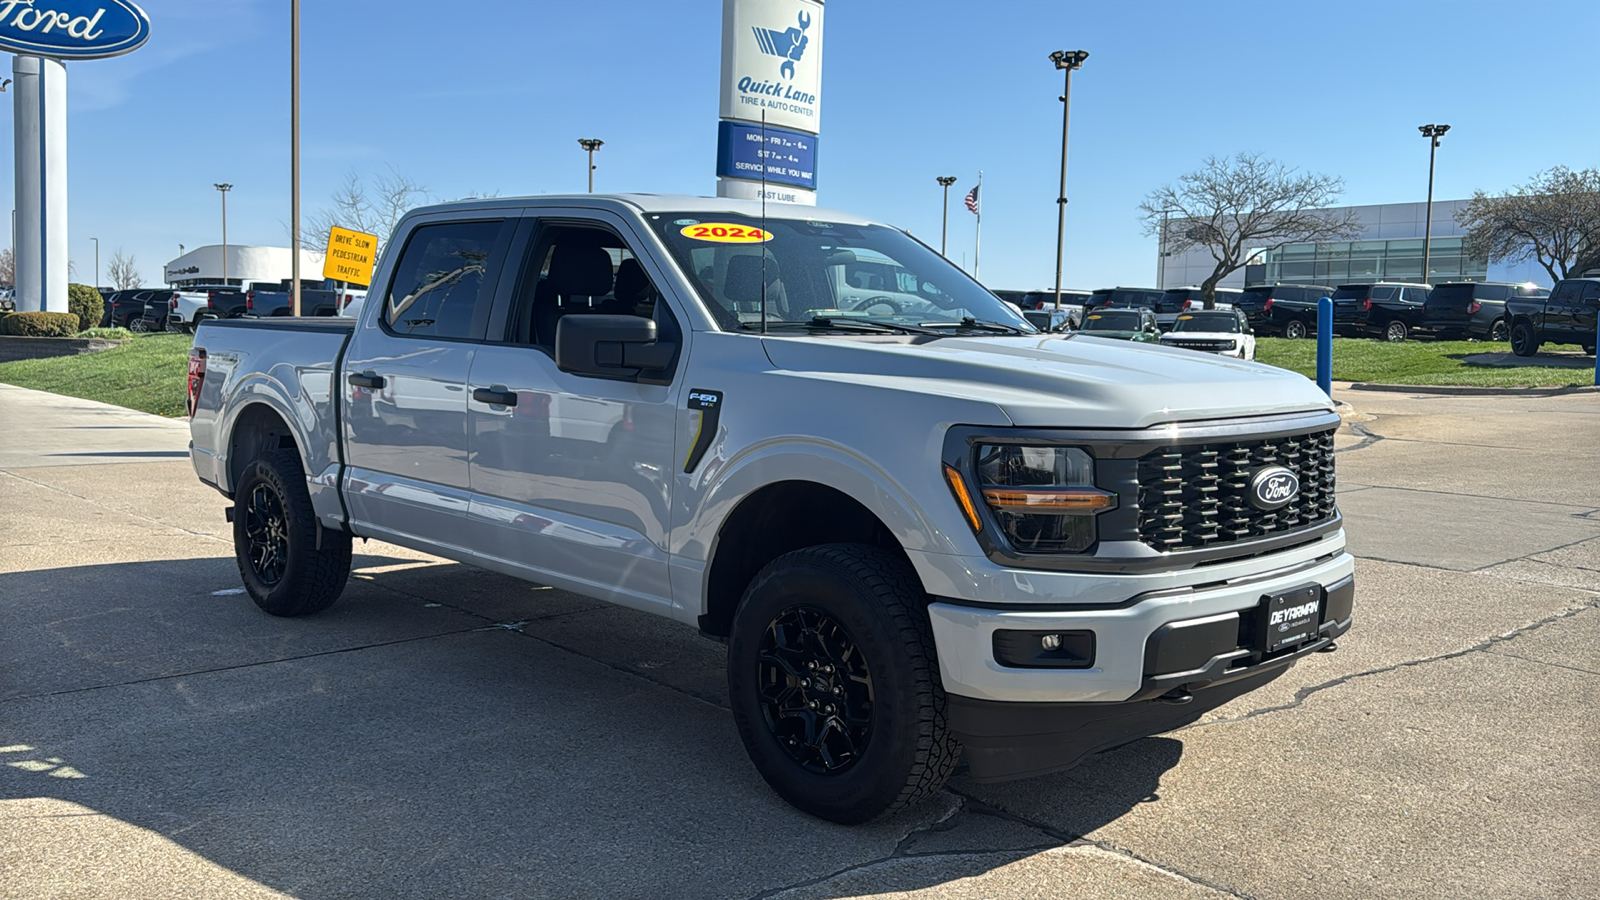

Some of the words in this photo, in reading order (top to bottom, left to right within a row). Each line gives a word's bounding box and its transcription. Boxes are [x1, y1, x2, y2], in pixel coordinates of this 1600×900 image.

[737, 76, 784, 97] Quick
[784, 85, 816, 105] Lane
[740, 95, 759, 106] TIRE
[760, 98, 766, 107] &
[767, 100, 788, 111] AUTO
[789, 104, 814, 117] CENTER
[746, 133, 763, 143] MON
[770, 136, 781, 145] FRI
[767, 165, 787, 175] WHILE
[788, 168, 800, 177] YOU
[801, 171, 813, 179] WAIT
[777, 193, 796, 202] LUBE
[693, 227, 764, 239] 2024
[335, 234, 353, 246] DRIVE
[355, 238, 370, 249] SLOW
[332, 248, 368, 263] PEDESTRIAN
[336, 264, 361, 277] TRAFFIC
[1265, 477, 1292, 499] Ford
[1269, 600, 1320, 626] DEYARMAN
